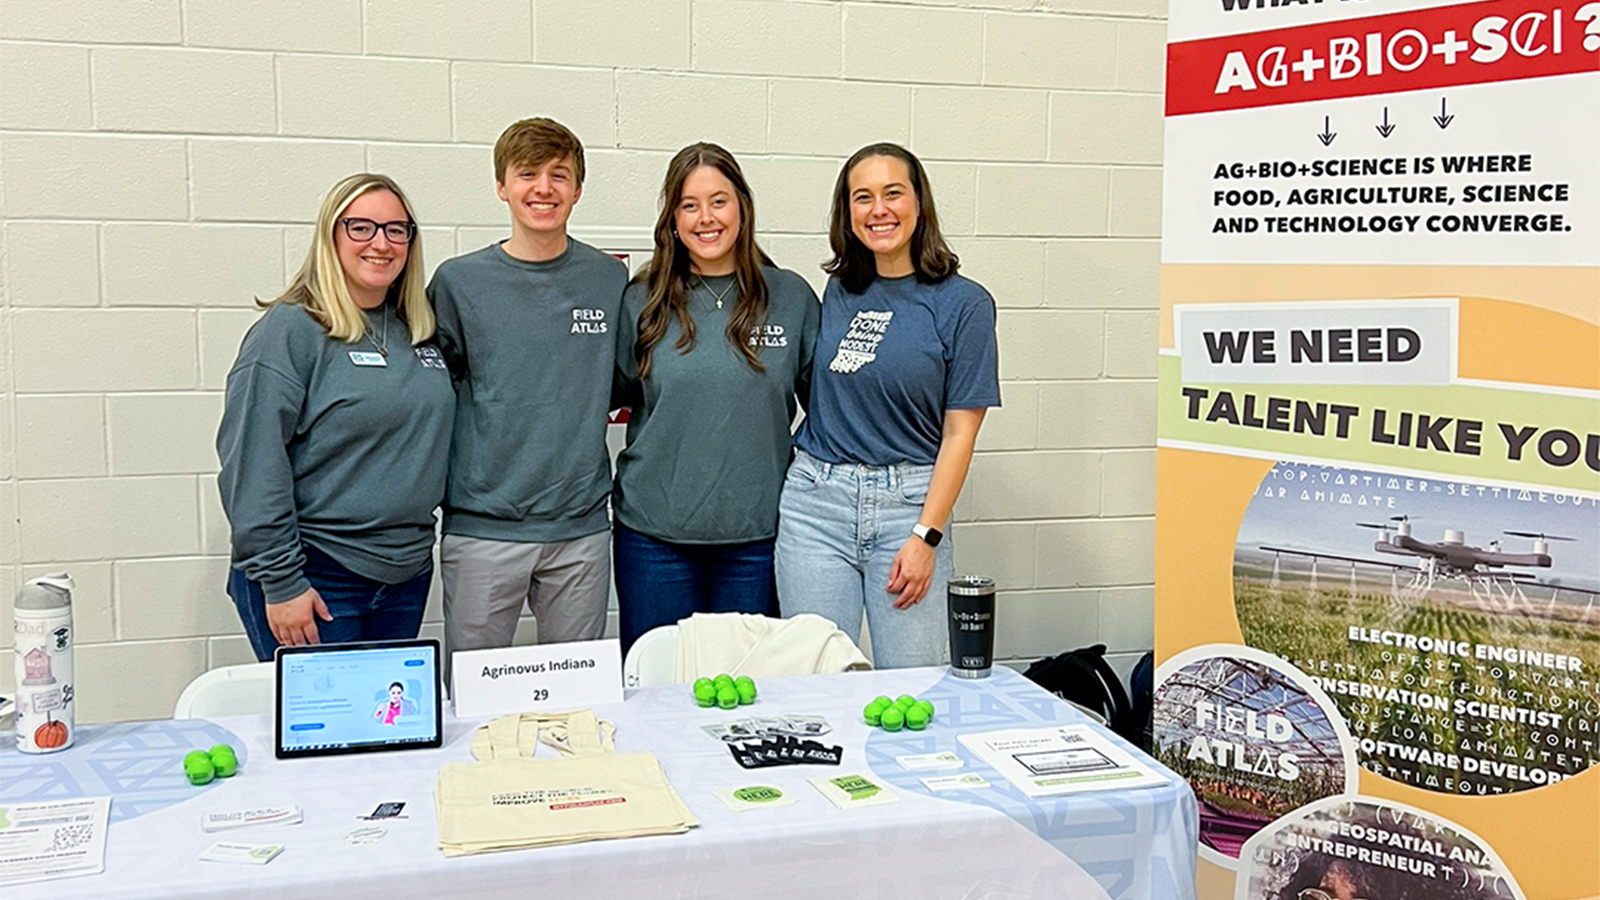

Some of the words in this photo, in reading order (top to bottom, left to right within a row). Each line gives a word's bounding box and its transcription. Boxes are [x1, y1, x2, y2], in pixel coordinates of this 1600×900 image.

[1213, 158, 1407, 179] AG+BIO+SCIENCE
[1413, 157, 1435, 175] IS
[1441, 154, 1532, 173] WHERE
[1213, 189, 1281, 209] FOOD,
[1286, 186, 1456, 207] AGRICULTURE,
[1462, 183, 1569, 203] SCIENCE
[1212, 217, 1259, 234] AND
[1264, 215, 1421, 233] TECHNOLOGY
[1425, 214, 1572, 233] CONVERGE.
[570, 321, 608, 334] ATLAS
[572, 308, 605, 321] FIELD
[849, 317, 890, 333] DONE
[1203, 330, 1277, 364] WE
[1290, 327, 1422, 363] NEED
[1182, 386, 1359, 439] TALENT
[1371, 409, 1483, 456] LIKE
[1300, 489, 1397, 509] ANIMATE
[1348, 625, 1471, 657] ELECTRONIC
[1475, 643, 1584, 674] ENGINEER
[481, 661, 546, 680] Agrinovus
[549, 657, 596, 671] Indiana
[532, 688, 549, 701] 29
[1308, 674, 1449, 712] ONSERVATION
[1453, 698, 1563, 730] SCIENTIST
[1196, 702, 1293, 744] FIELD
[1187, 735, 1301, 782] ATLAS
[1351, 735, 1459, 769] SOFTWARE
[1330, 820, 1446, 858] GEOSPATIAL
[1287, 832, 1437, 878] ENTREPRENEUR
